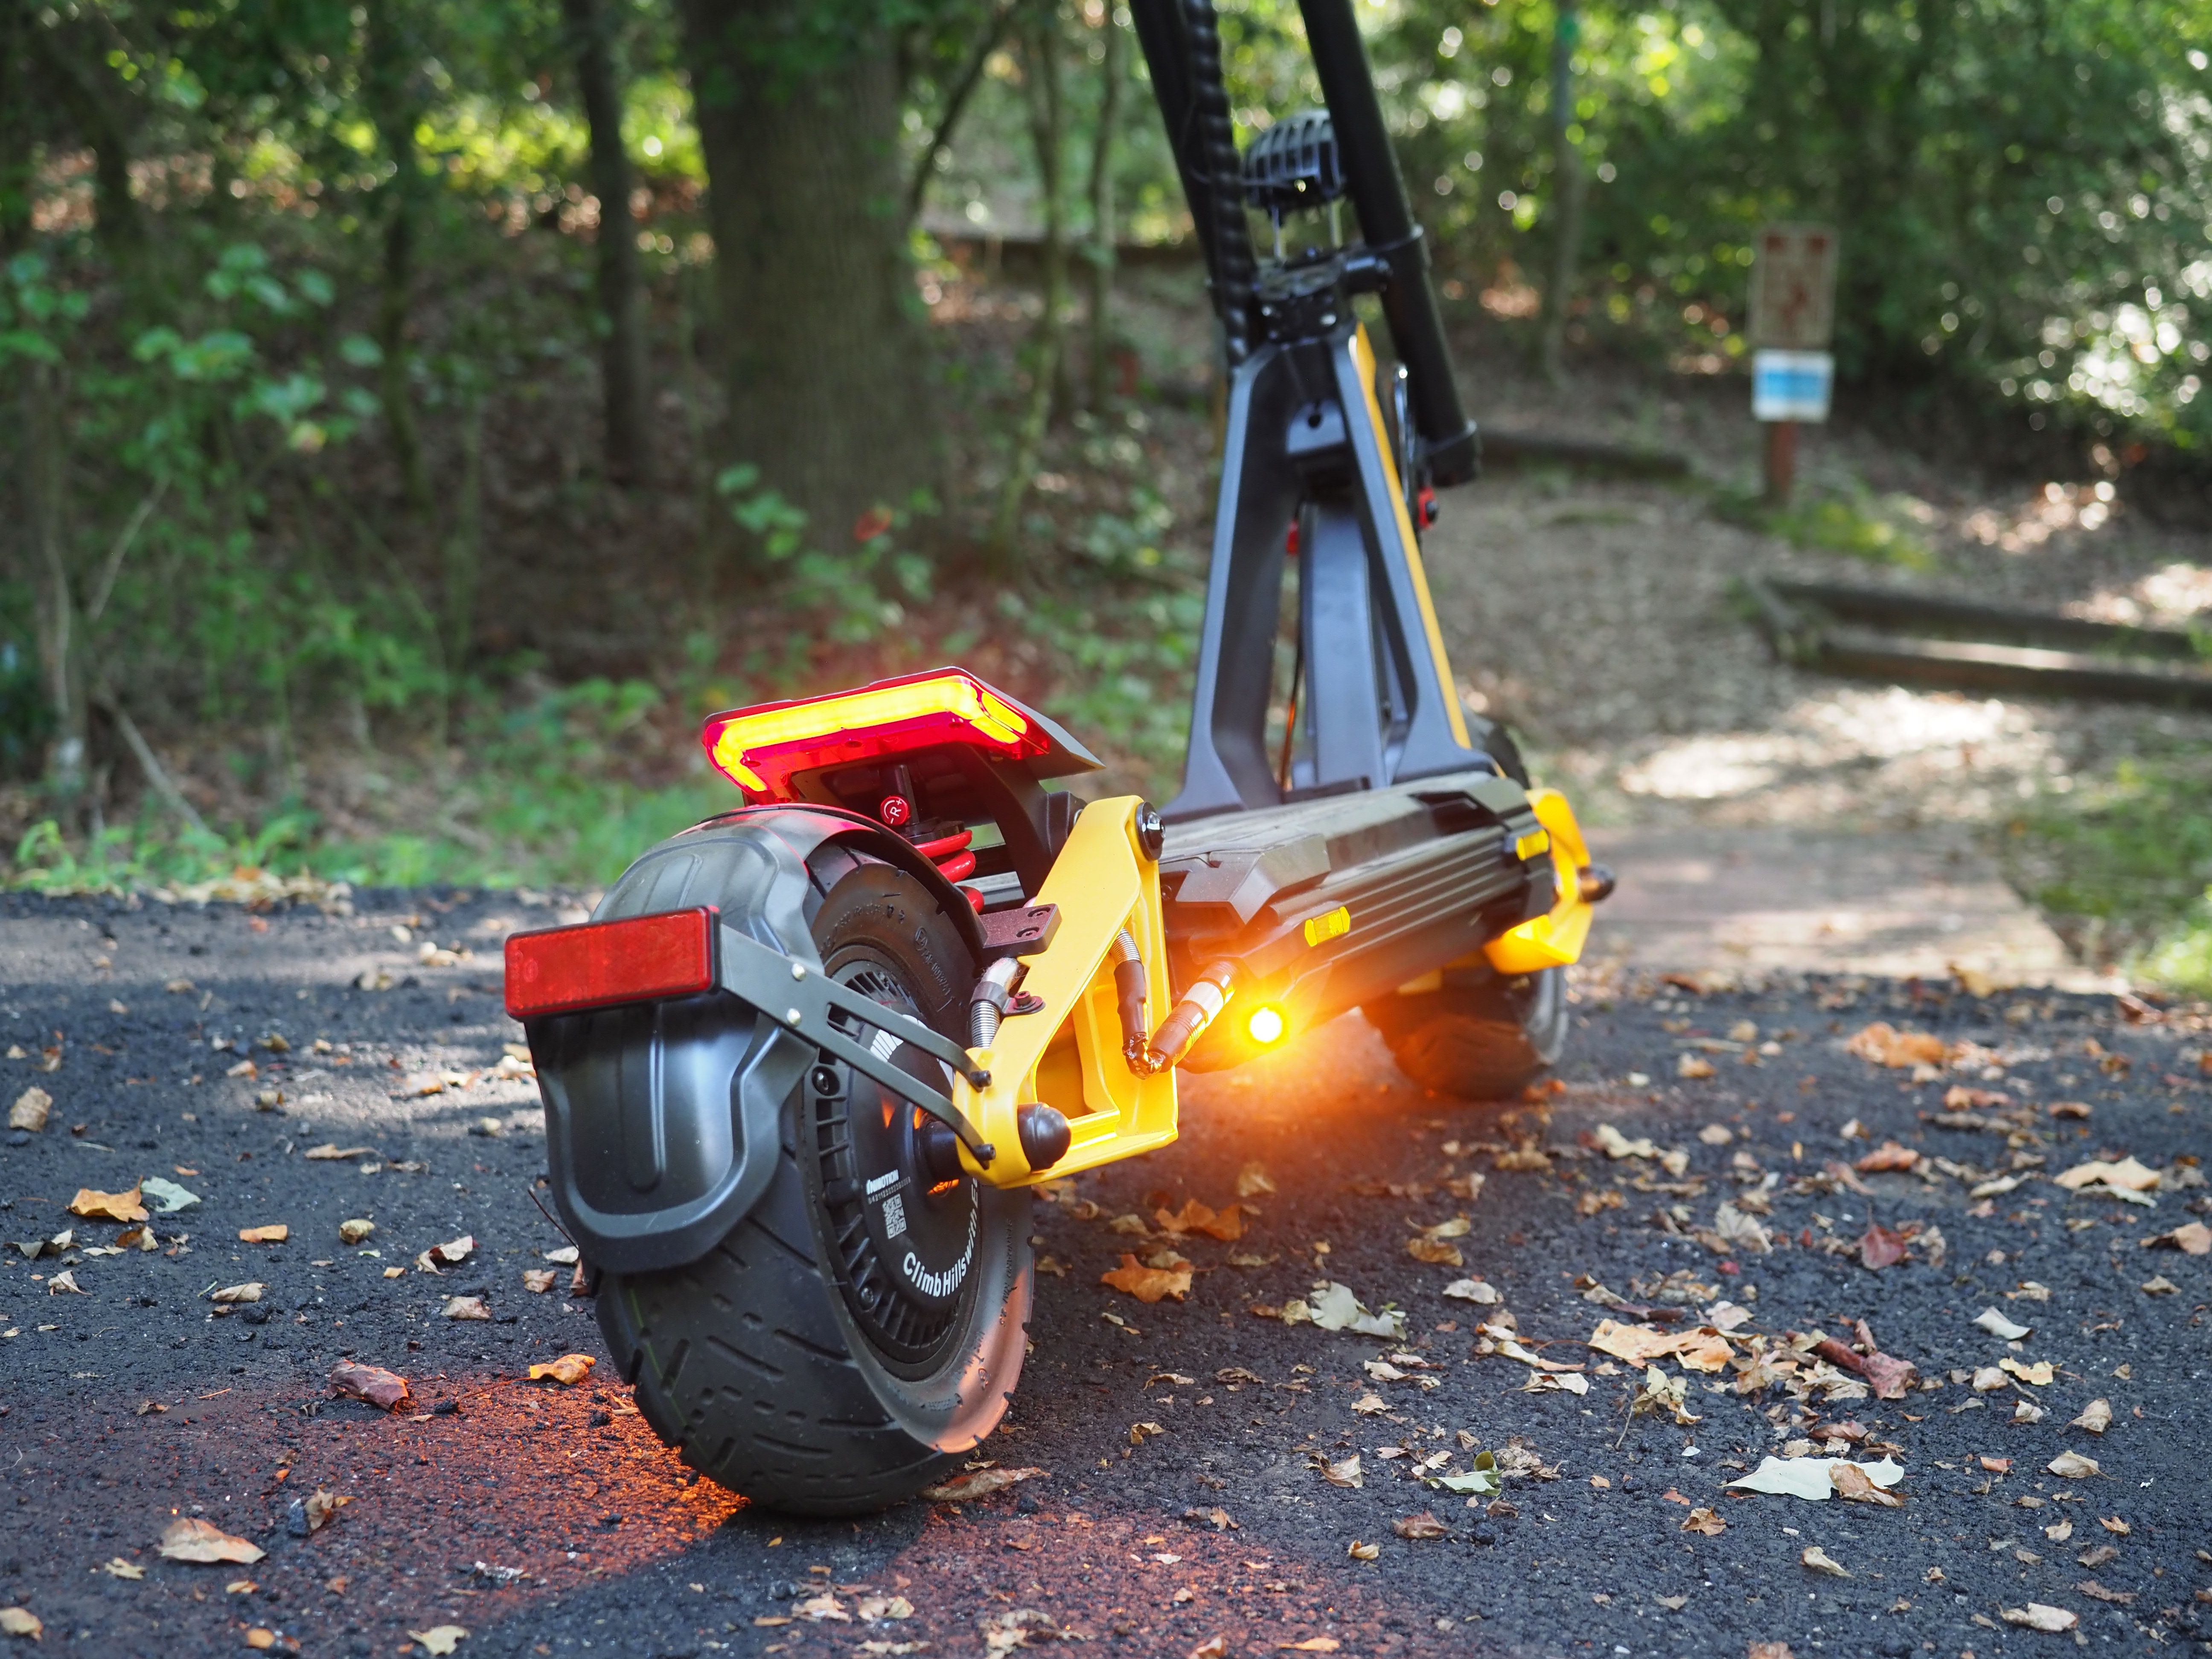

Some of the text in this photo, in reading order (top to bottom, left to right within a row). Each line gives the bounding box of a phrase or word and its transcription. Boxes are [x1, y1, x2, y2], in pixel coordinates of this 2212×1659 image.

[890, 806, 902, 817] R
[903, 1252, 942, 1297] Climb
[943, 1256, 967, 1297] Hills
[965, 1208, 977, 1265] with
